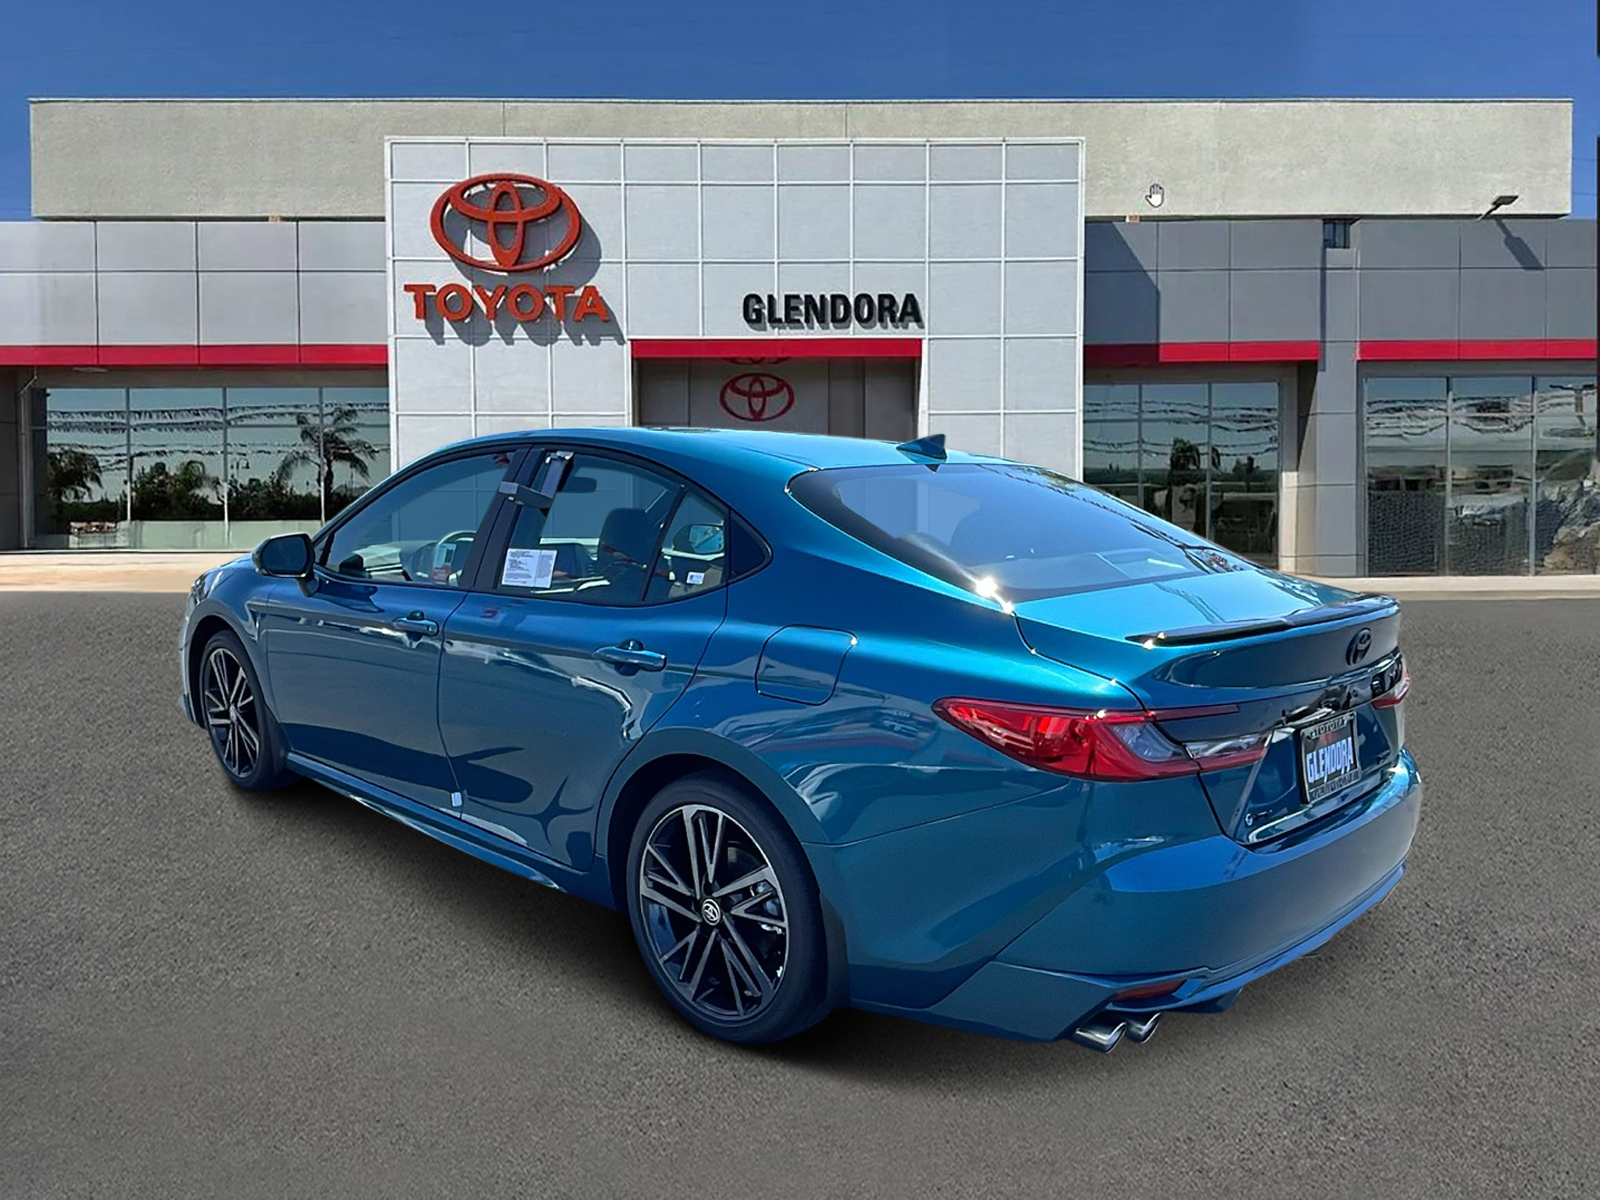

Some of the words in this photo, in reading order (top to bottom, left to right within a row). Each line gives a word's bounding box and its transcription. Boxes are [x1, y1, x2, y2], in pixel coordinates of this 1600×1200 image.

[404, 284, 610, 322] TOYOTA
[743, 293, 923, 326] GLENDORA
[1306, 737, 1354, 783] GLENDORA
